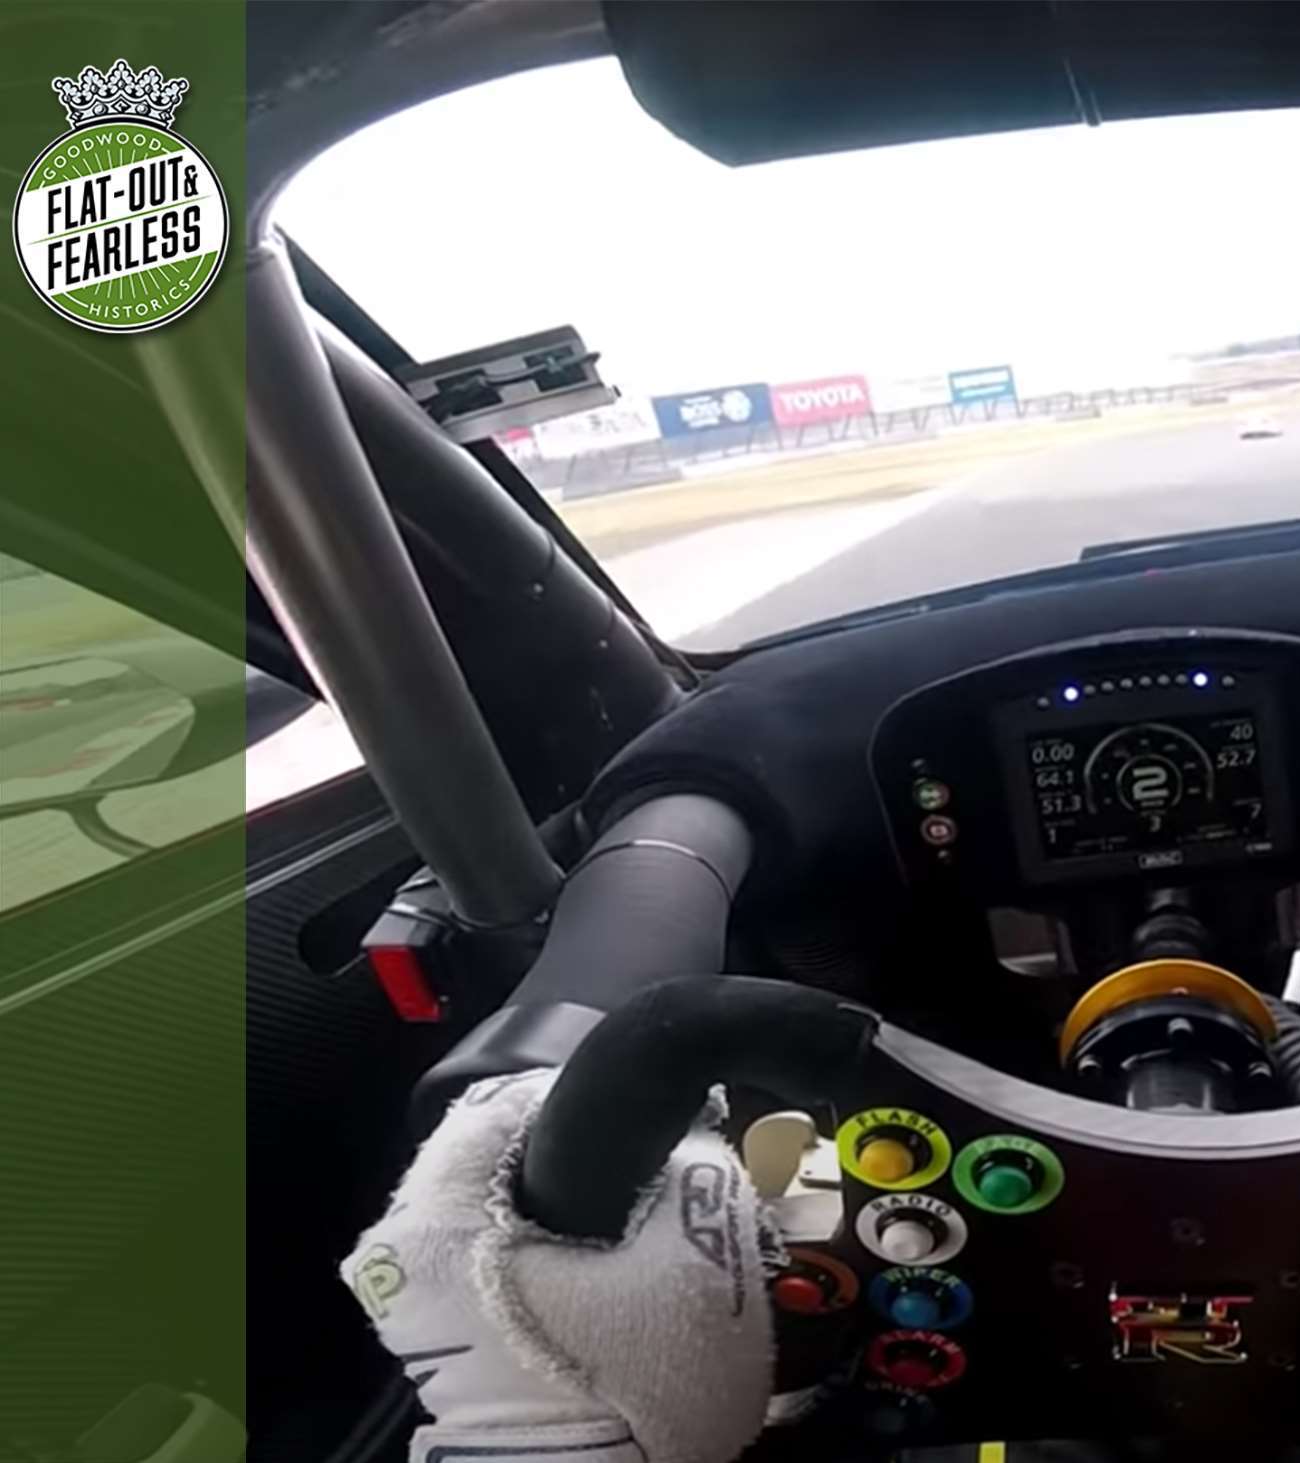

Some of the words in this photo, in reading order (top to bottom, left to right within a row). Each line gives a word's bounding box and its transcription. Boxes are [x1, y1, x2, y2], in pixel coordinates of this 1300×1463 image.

[779, 384, 866, 412] TOYOTA
[1230, 724, 1254, 741] 40
[1032, 743, 1075, 764] 0.00
[1216, 749, 1257, 769] 52.7
[1036, 769, 1075, 788] 64.1
[1131, 765, 1170, 801] 2
[1041, 794, 1082, 815] 51.3
[856, 1110, 937, 1135] FLASH
[871, 1195, 950, 1217] RADIO
[881, 1266, 962, 1289] WIPER
